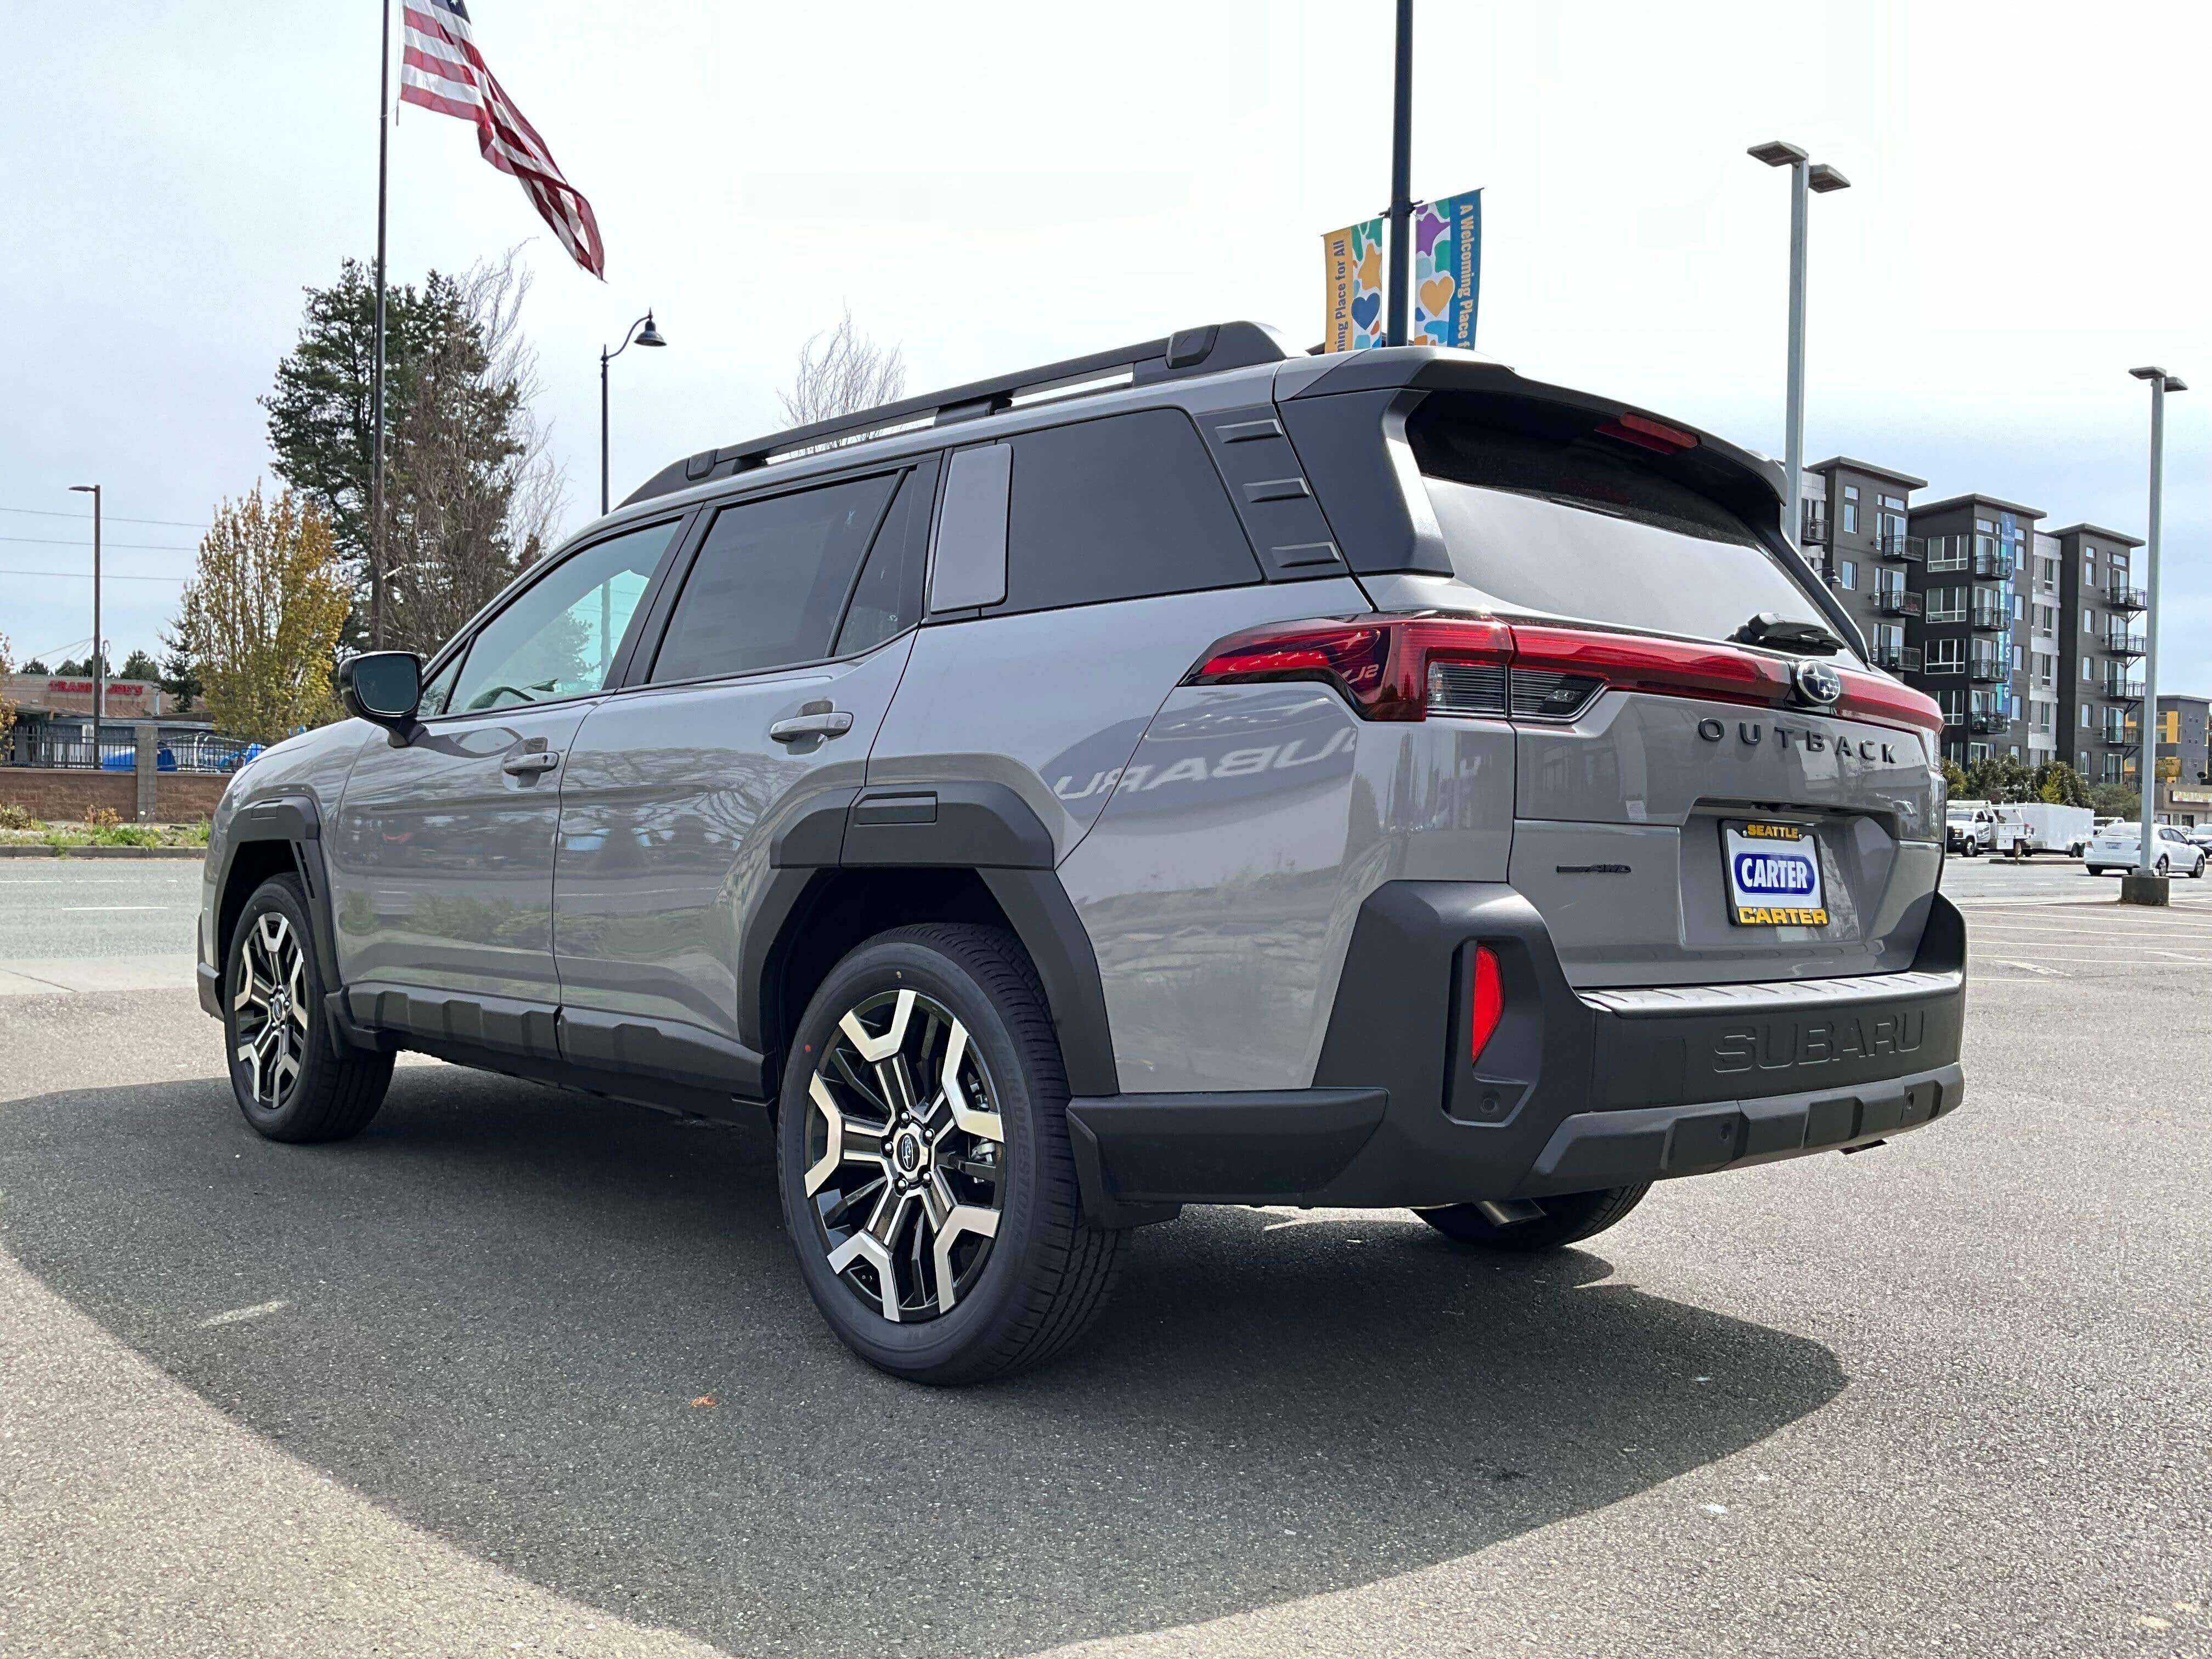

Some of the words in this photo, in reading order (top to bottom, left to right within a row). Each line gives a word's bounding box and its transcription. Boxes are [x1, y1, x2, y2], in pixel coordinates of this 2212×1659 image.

[1460, 204, 1473, 215] A
[1333, 239, 1345, 256] All
[1458, 215, 1475, 299] Welcoming
[1335, 260, 1346, 281] for
[1334, 282, 1346, 320] Place
[1458, 299, 1474, 339] Place
[48, 680, 103, 693] TRADE
[1698, 718, 1897, 764] OUTBACK
[1747, 825, 1798, 839] SEATTLE
[1741, 857, 1808, 889] CARTER
[1738, 906, 1828, 924] CARTER
[1712, 1010, 1924, 1073] SUBARU
